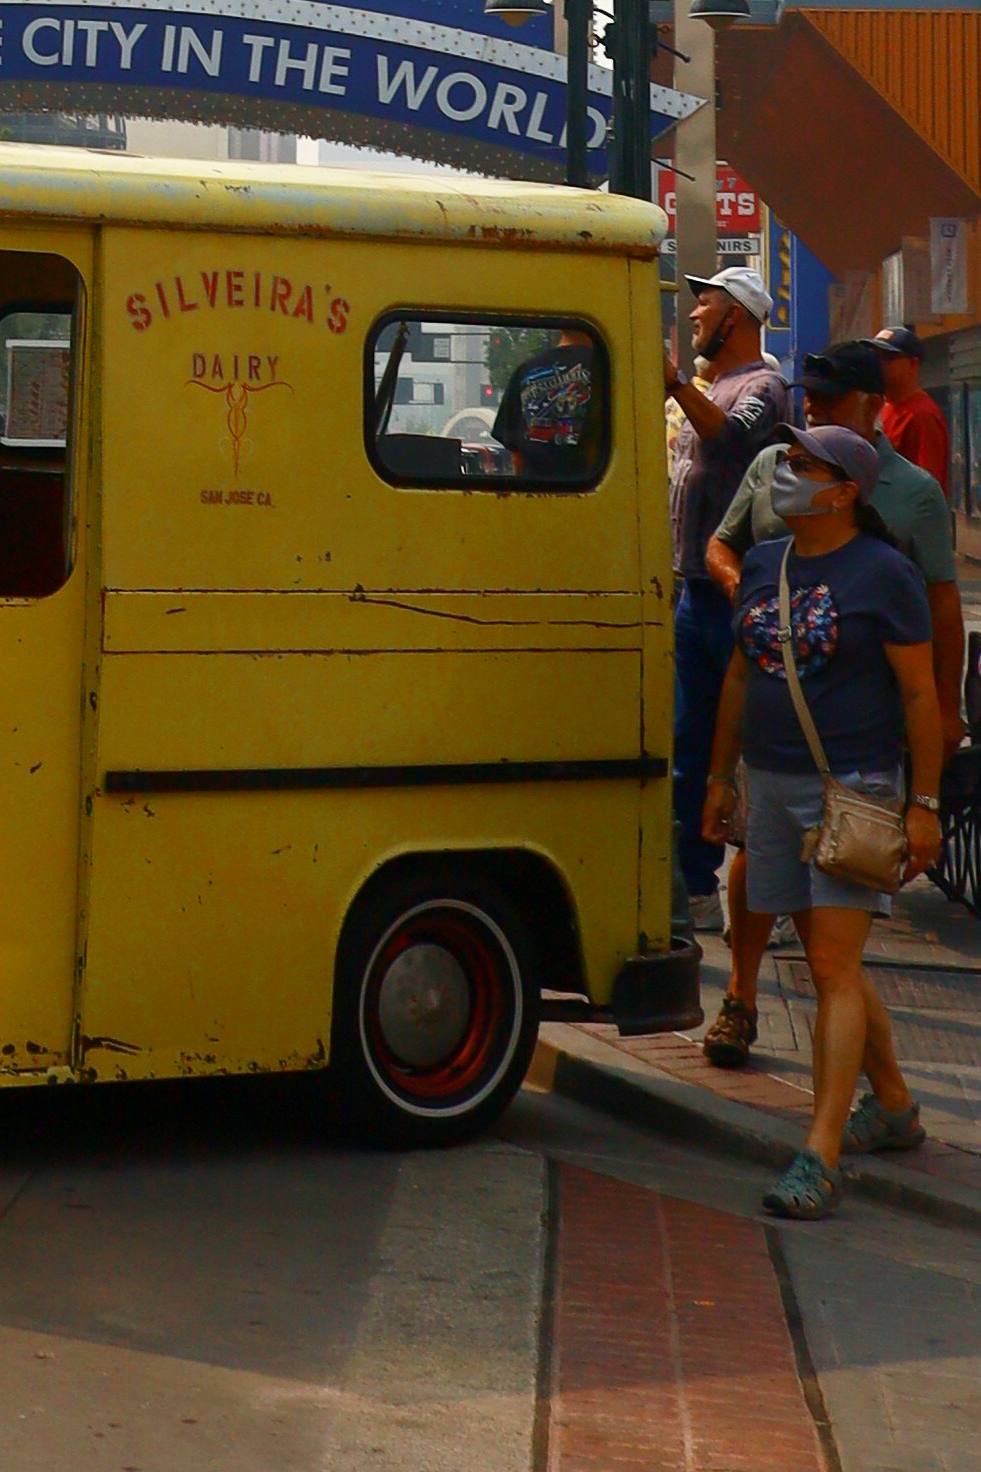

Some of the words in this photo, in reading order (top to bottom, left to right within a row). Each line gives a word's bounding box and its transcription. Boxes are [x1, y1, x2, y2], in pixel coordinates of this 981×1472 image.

[21, 17, 146, 72] CITY
[161, 25, 223, 77] IN
[242, 35, 352, 96] THE
[126, 270, 351, 334] SILVEIRA'S
[192, 353, 279, 380] DAIRY
